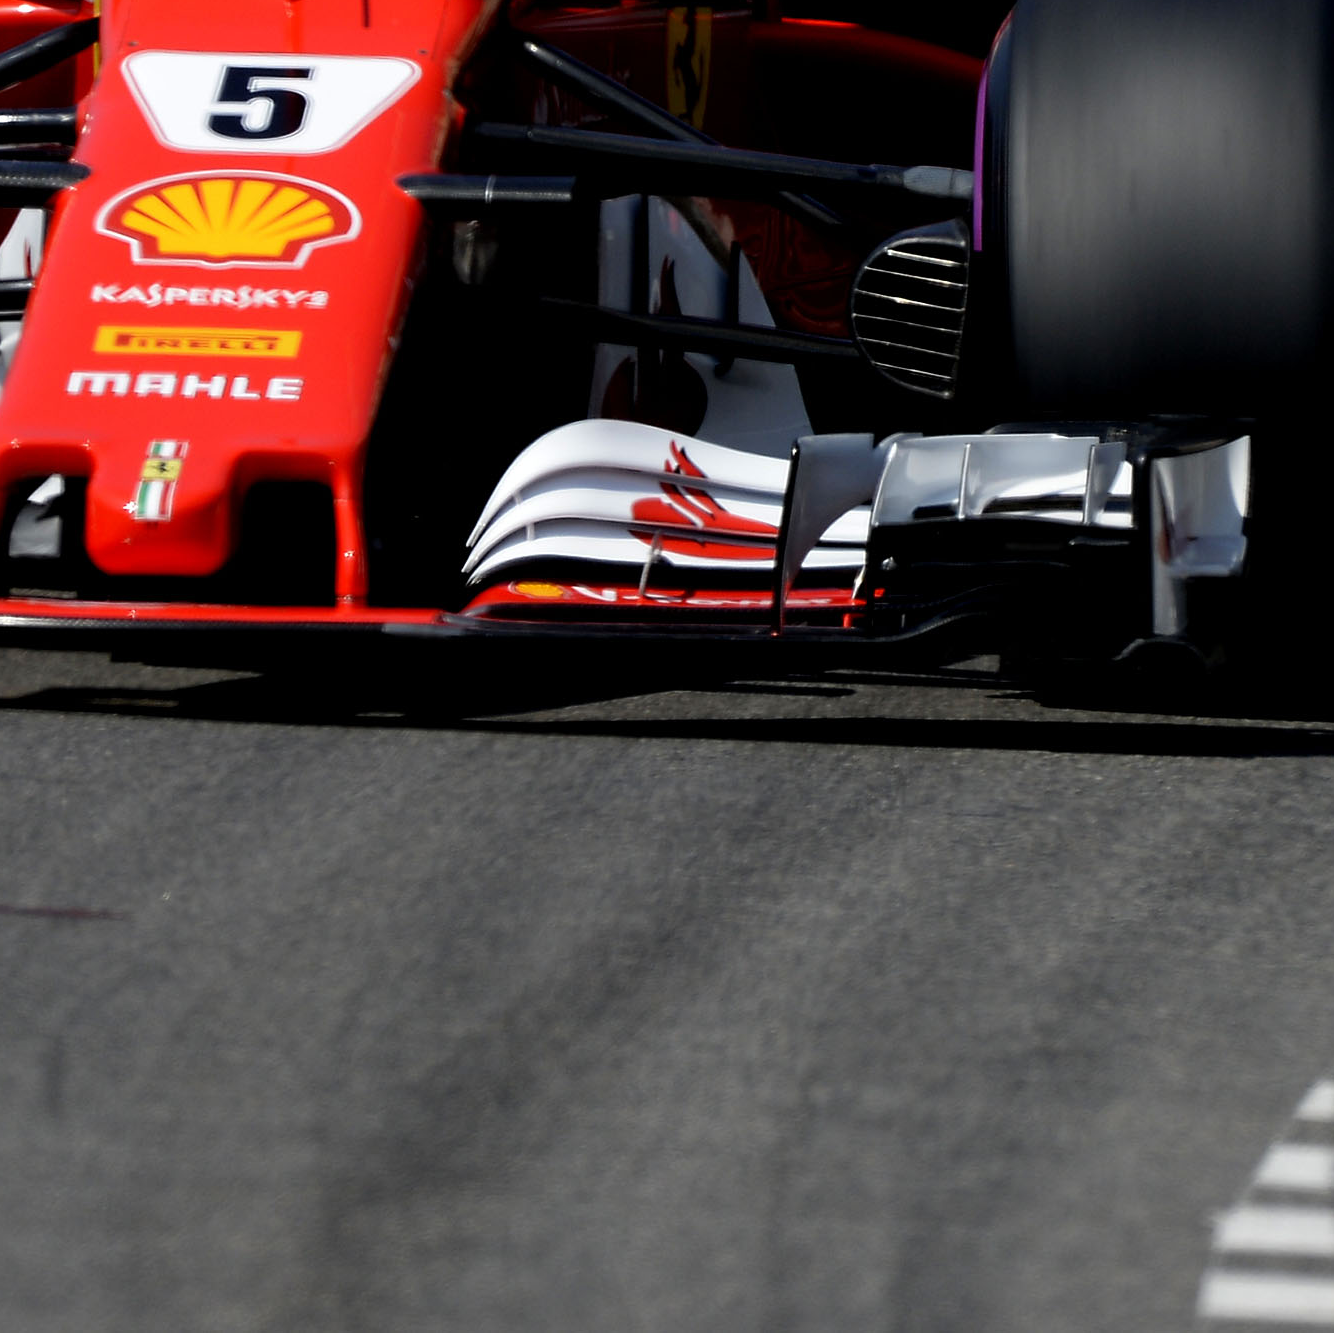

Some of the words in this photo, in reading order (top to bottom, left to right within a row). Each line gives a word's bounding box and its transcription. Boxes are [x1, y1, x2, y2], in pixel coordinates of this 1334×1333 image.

[207, 66, 315, 140] 5
[91, 283, 311, 309] KASPERSKY
[114, 333, 281, 351] PIRELLI
[67, 371, 305, 400] MAHLE
